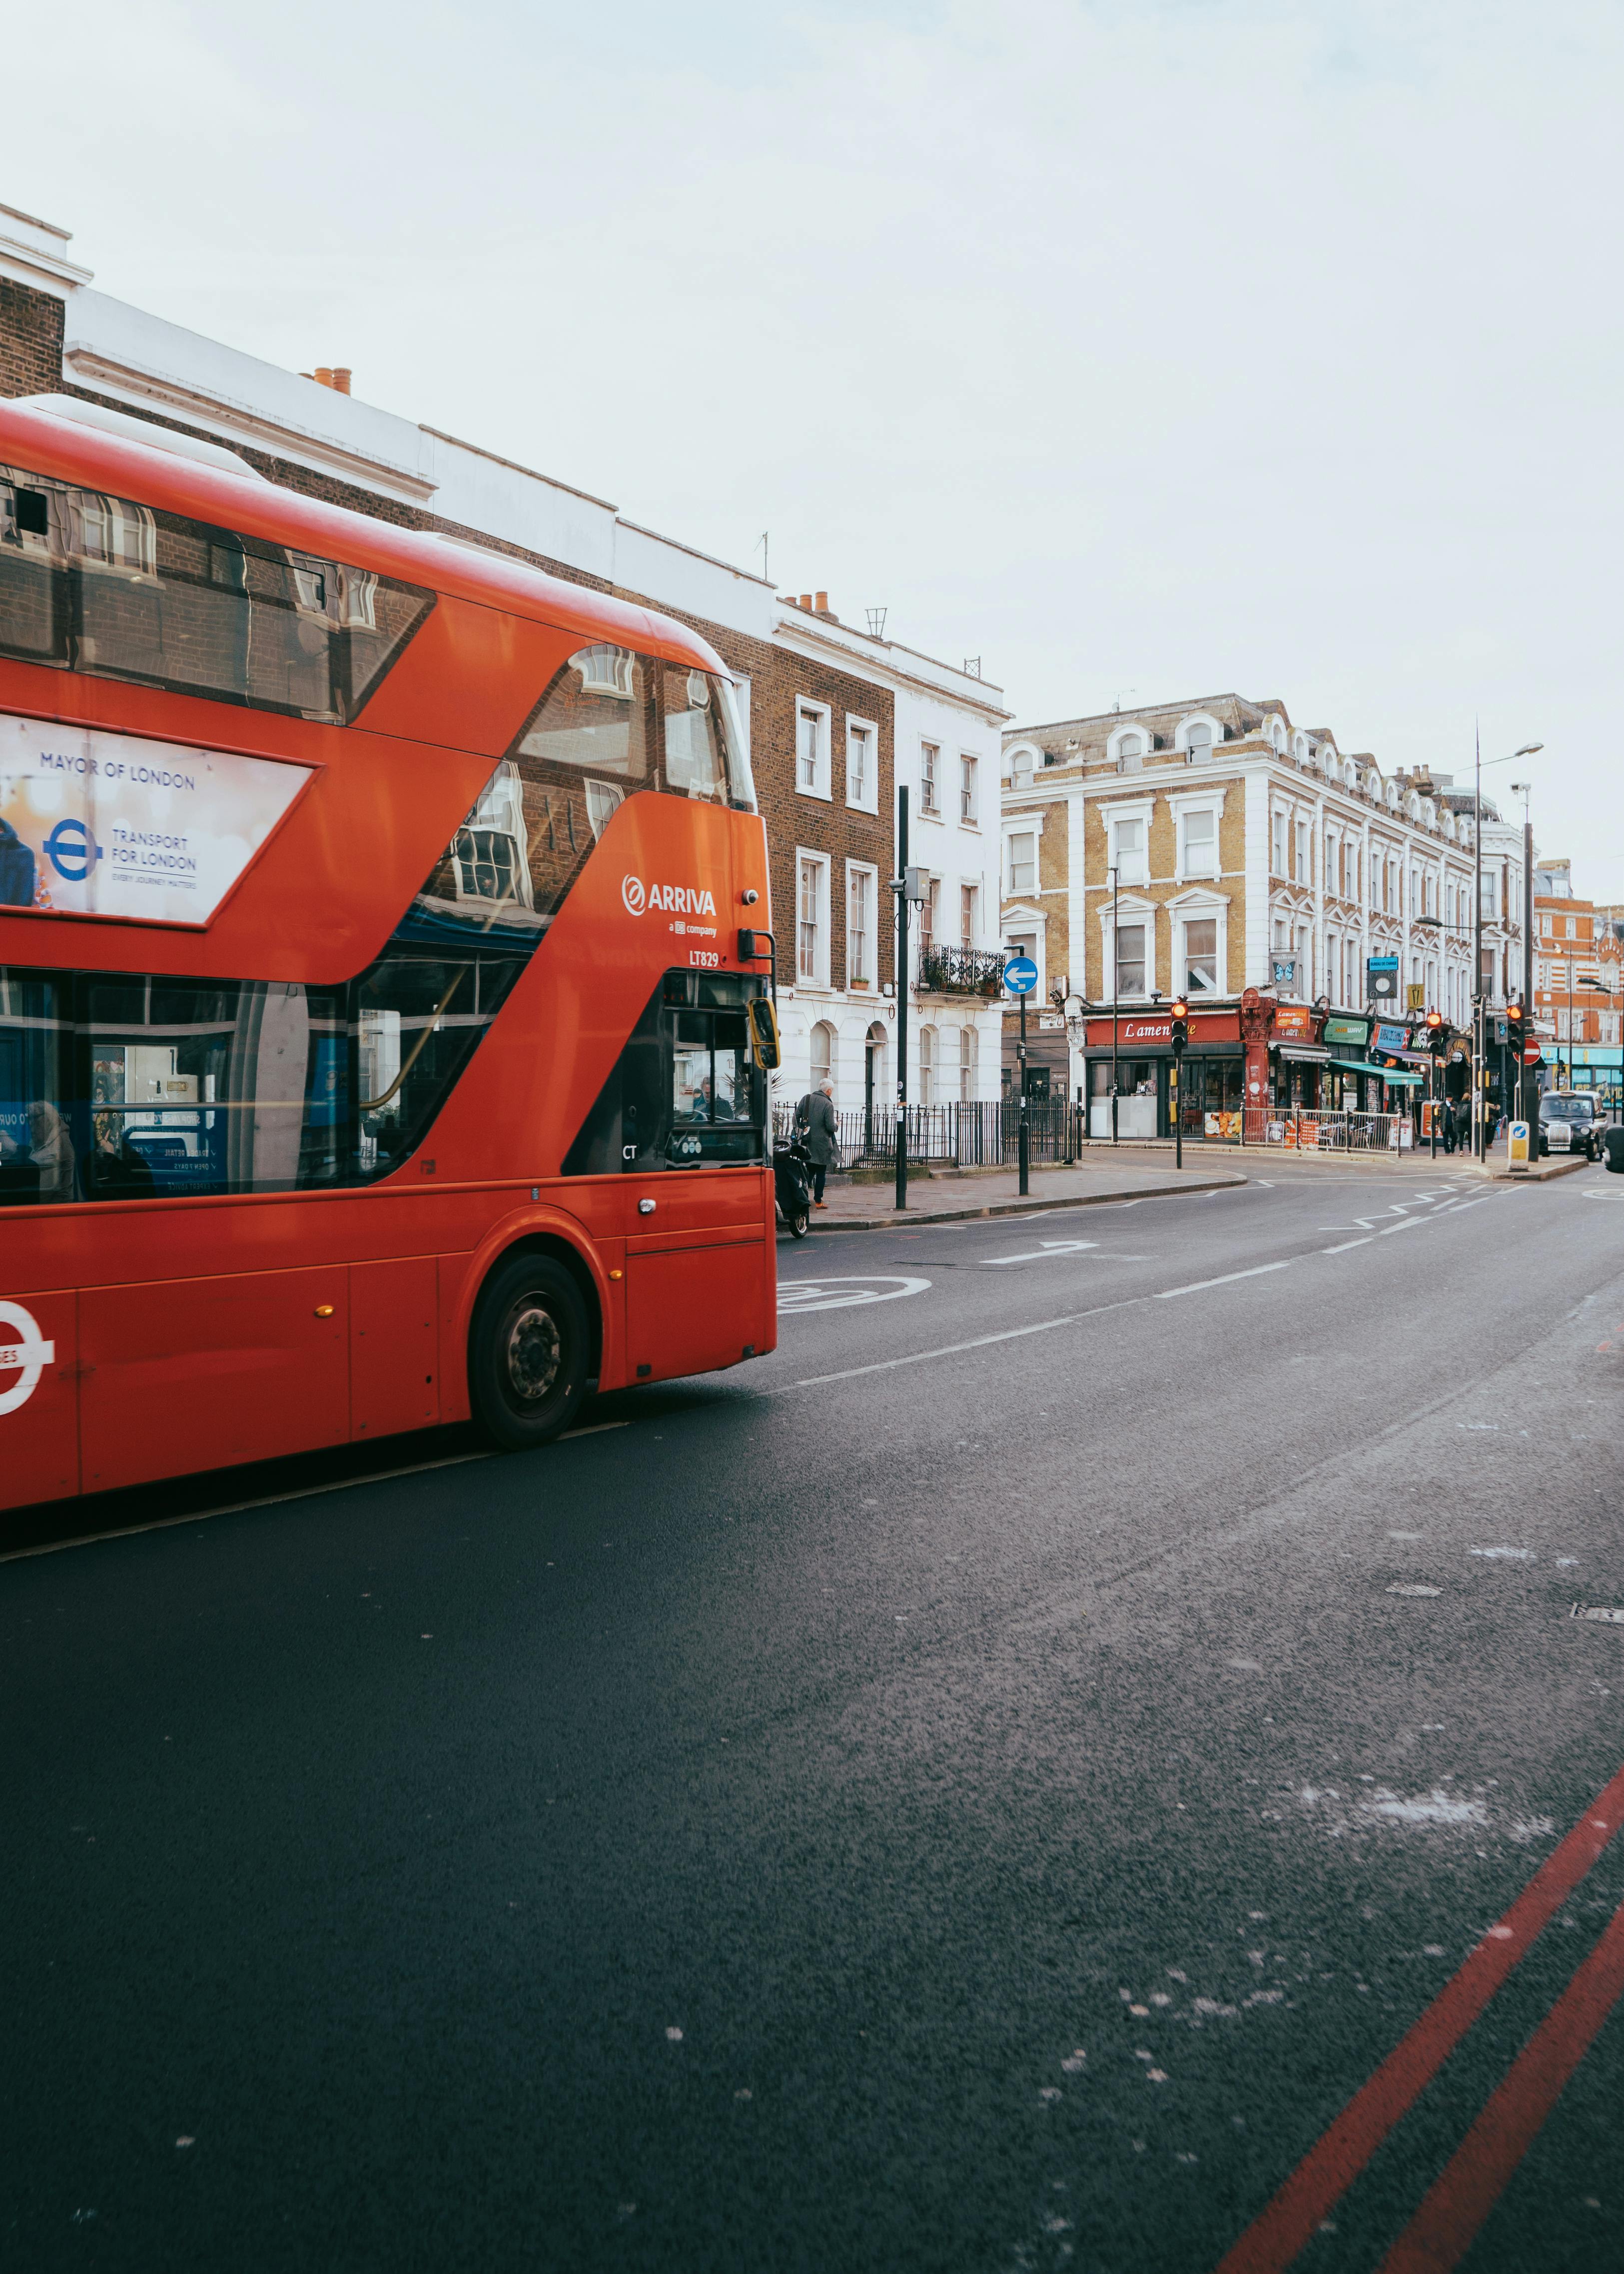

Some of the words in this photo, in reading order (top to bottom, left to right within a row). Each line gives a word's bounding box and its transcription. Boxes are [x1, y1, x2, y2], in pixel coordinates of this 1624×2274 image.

[40, 752, 99, 775] MAYOR
[104, 762, 125, 779] OF
[130, 766, 195, 790] LONDON
[112, 829, 188, 850] TRANSPORT
[112, 848, 138, 863] FOR
[141, 852, 196, 870] LONDON
[135, 876, 165, 885] JOURNEY
[167, 880, 196, 889] MATTERS
[648, 884, 717, 916] ARRIVA
[675, 922, 686, 934] DB
[687, 925, 717, 938] company
[690, 950, 719, 967] LT829
[1125, 1024, 1196, 1037] Lamene
[727, 1058, 734, 1069] 12
[623, 1145, 637, 1159] CT
